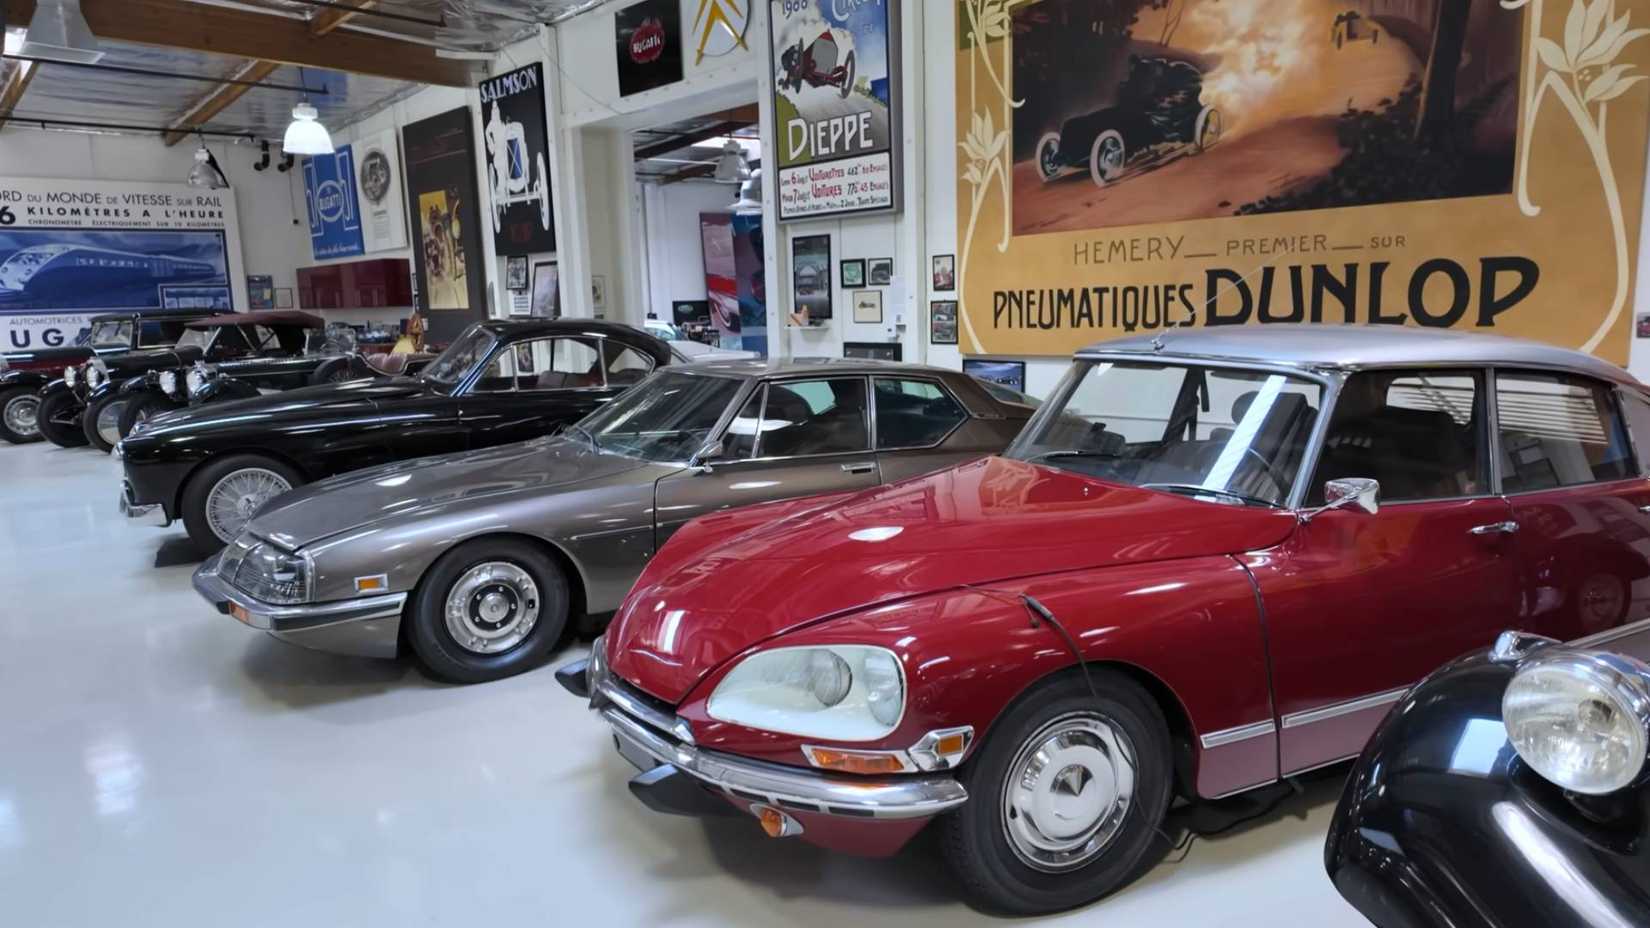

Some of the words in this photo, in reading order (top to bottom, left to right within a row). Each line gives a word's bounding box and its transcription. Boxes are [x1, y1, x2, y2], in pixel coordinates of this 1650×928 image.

[481, 66, 537, 103] SALMSON
[788, 112, 873, 160] DIEPPE
[0, 190, 22, 201] RD
[27, 194, 41, 202] DU
[46, 192, 102, 204] MONDE
[106, 196, 118, 204] DE
[122, 194, 172, 206] VITESSE
[196, 196, 222, 207] RAIL
[165, 209, 223, 218] L'HEURE
[1073, 236, 1184, 264] HEMERY
[1226, 234, 1327, 256] PREMIER
[1370, 235, 1406, 249] SUR
[993, 284, 1196, 331] PNEUMATIQUES
[1204, 256, 1540, 328] DUNLOP
